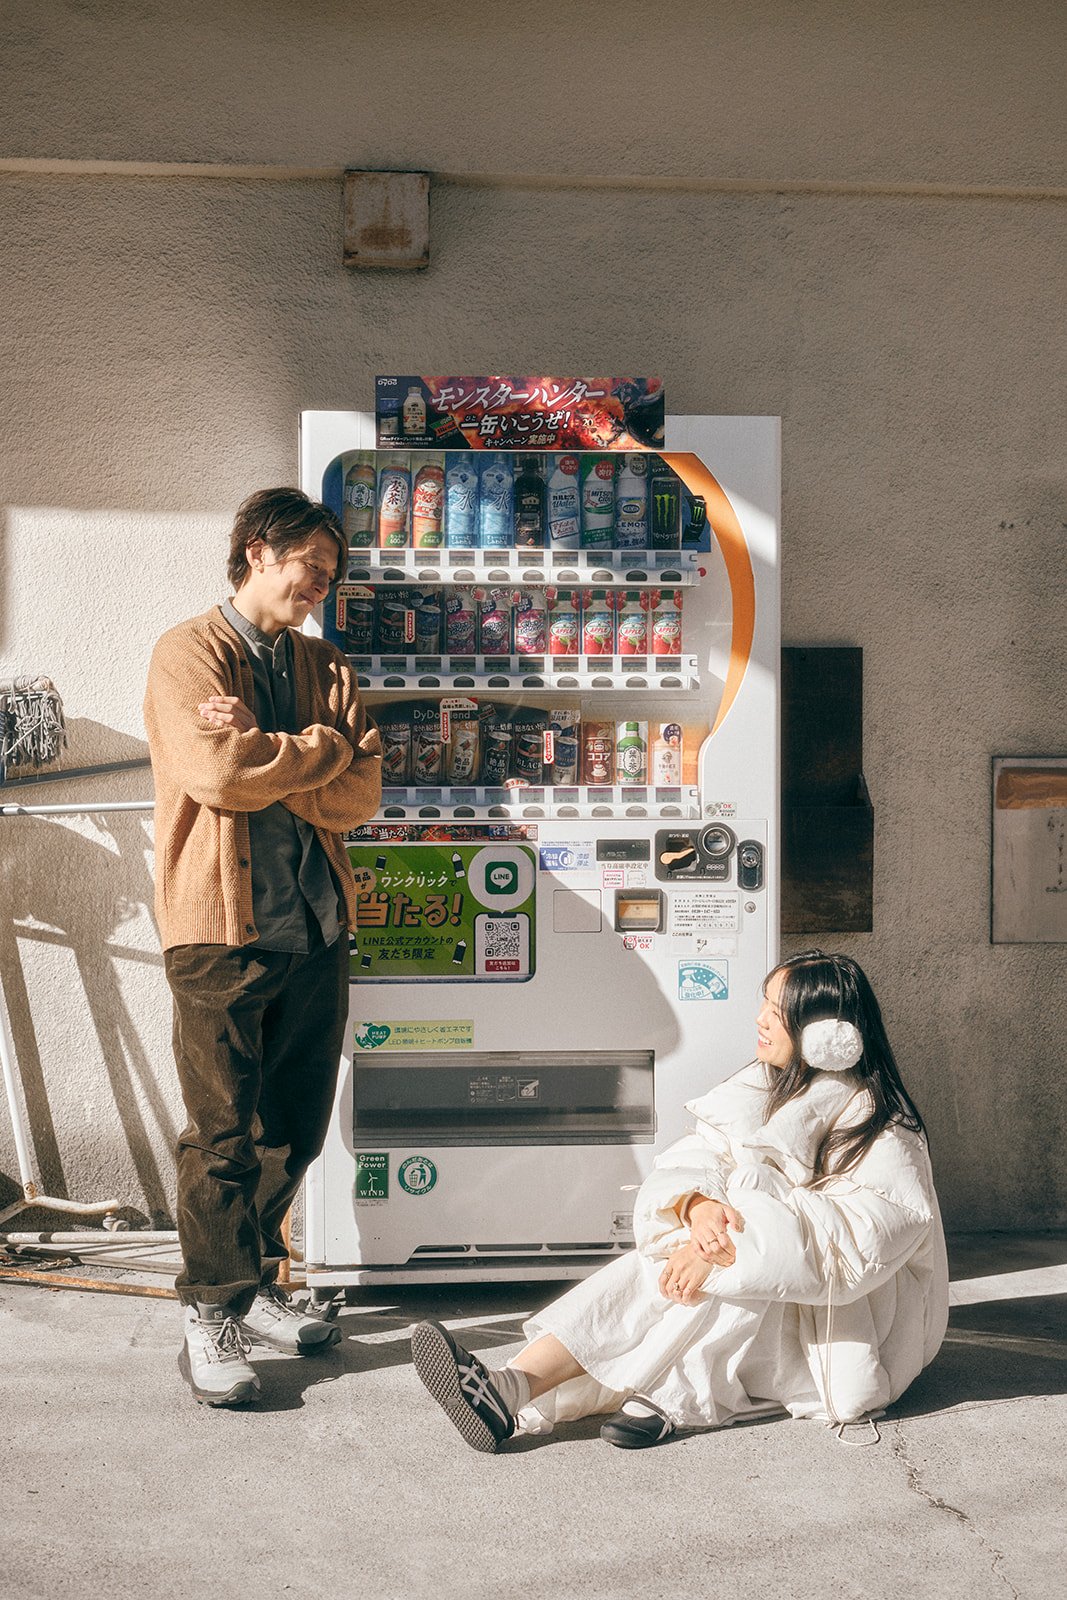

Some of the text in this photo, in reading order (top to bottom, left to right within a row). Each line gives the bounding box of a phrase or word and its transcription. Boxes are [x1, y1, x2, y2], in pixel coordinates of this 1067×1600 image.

[432, 381, 605, 411] モンスターハンター
[461, 410, 571, 435] 一缶いこうぜ!
[485, 433, 555, 446] キャンペーン実施中
[458, 490, 474, 511] 水
[493, 490, 509, 511] 水
[552, 500, 576, 508] Water
[413, 710, 470, 720] DyDolend
[588, 752, 609, 761] ココア
[355, 872, 371, 882] 商品
[494, 873, 509, 881] LINE
[357, 893, 463, 928] 当たる!
[363, 937, 454, 946] LINE公式アカウントの
[378, 949, 435, 960] 友だち限定
[394, 1026, 472, 1034] 環境にやさしく省エネです
[404, 1185, 432, 1195] リサイクル
